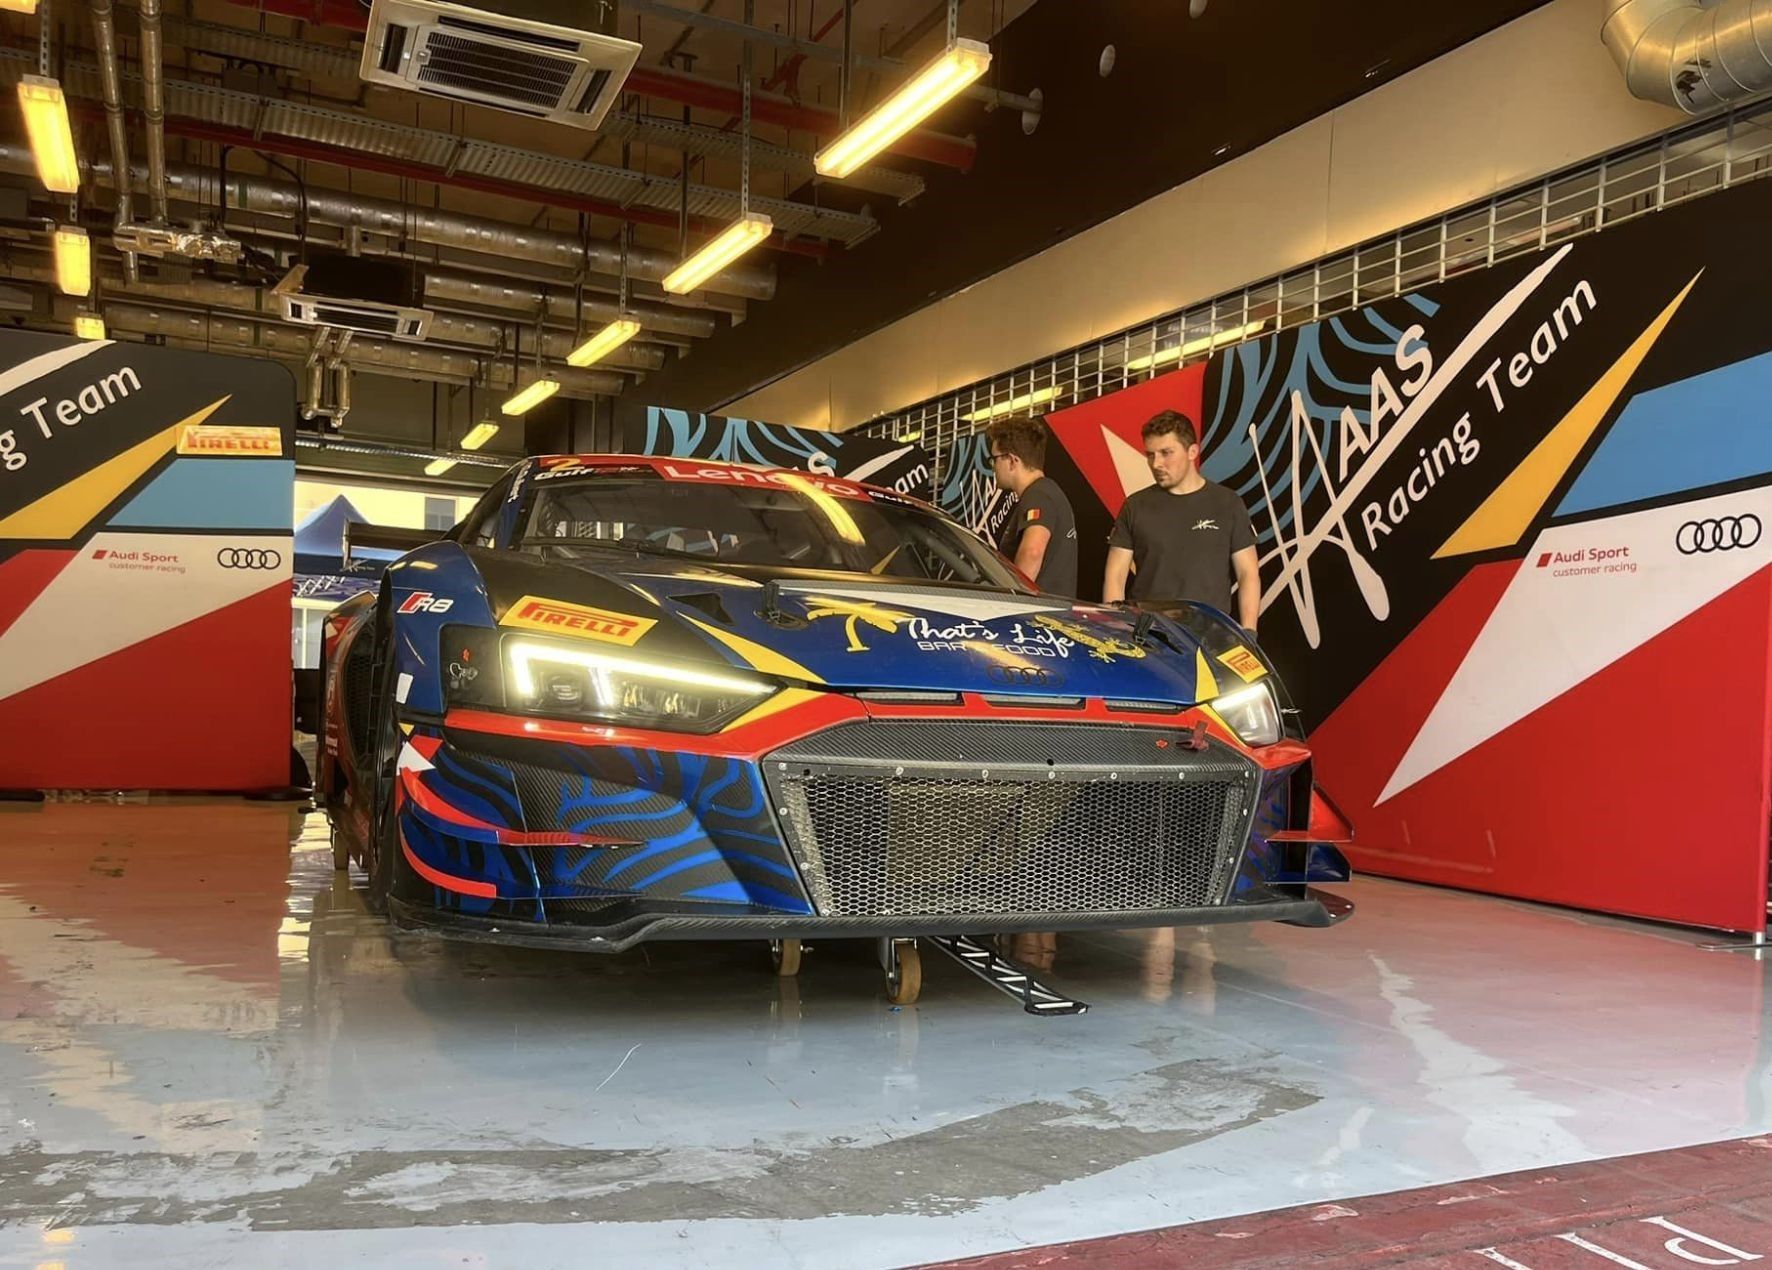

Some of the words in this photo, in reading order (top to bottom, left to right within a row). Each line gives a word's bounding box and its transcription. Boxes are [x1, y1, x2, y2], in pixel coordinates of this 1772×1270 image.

[20, 367, 142, 439] Team
[1361, 412, 1482, 551] Racing
[1476, 279, 1599, 412] Team
[187, 430, 270, 449] PIRELLI
[664, 466, 859, 496] Lenoo
[109, 550, 139, 560] Audi
[142, 552, 178, 564] Sport
[1554, 550, 1585, 563] Audi
[1588, 547, 1630, 562] Sport
[109, 563, 155, 571] customer
[157, 565, 186, 574] racing
[1553, 565, 1601, 578] customer
[1603, 562, 1638, 575] racing
[398, 591, 454, 614] R8
[517, 602, 640, 638] PIRELLI
[908, 617, 999, 641] That's
[1010, 623, 1075, 658] Life
[917, 641, 968, 652] BAR
